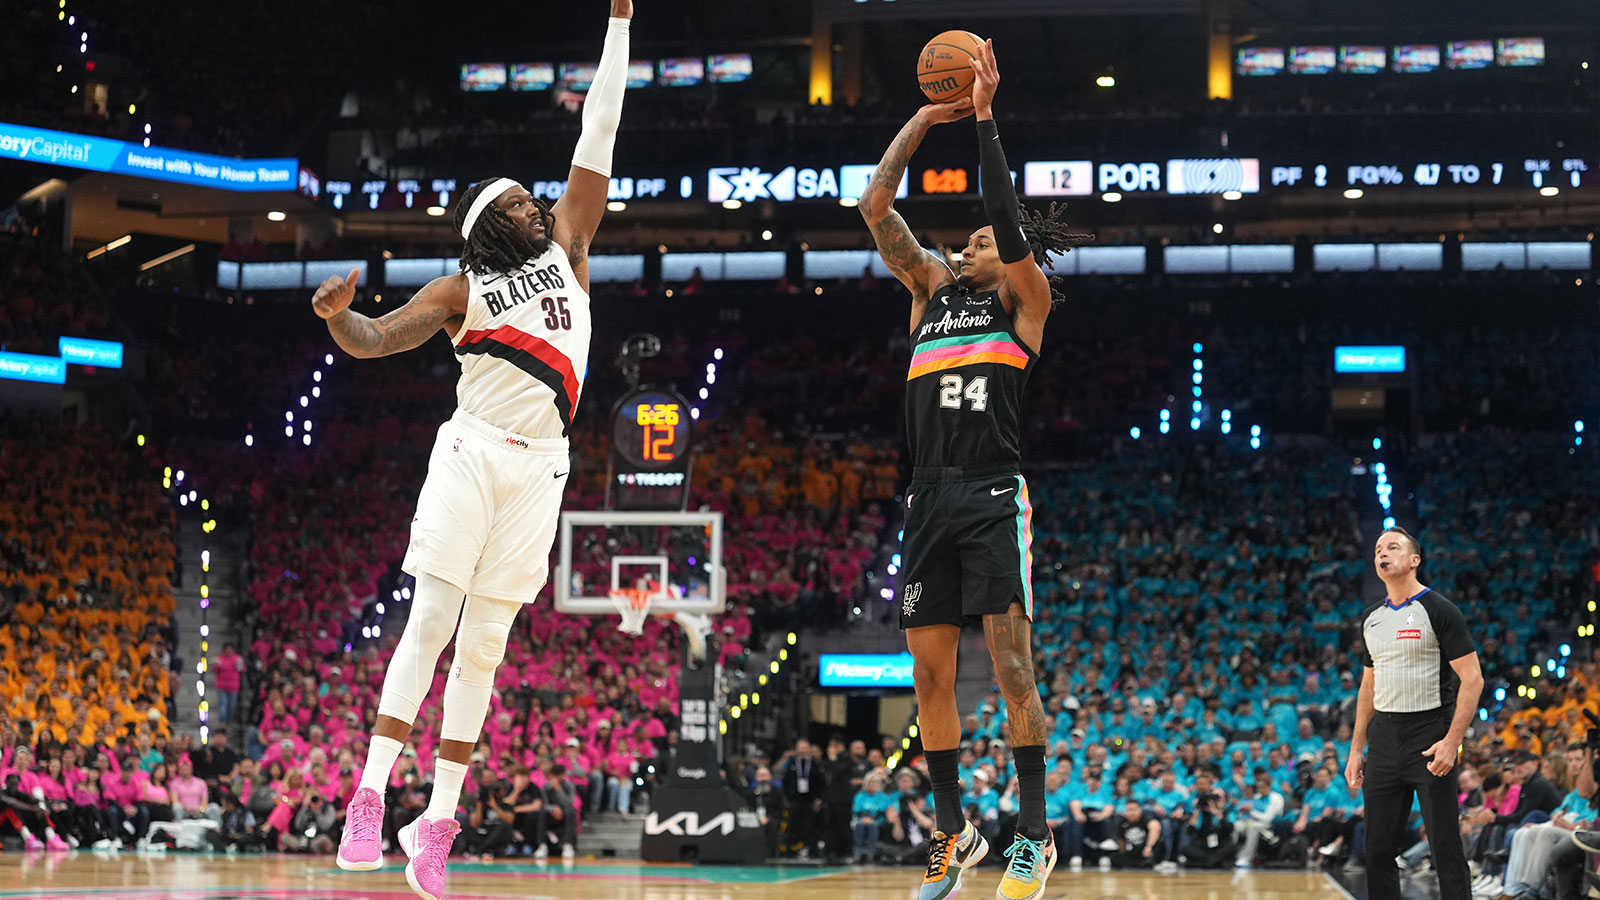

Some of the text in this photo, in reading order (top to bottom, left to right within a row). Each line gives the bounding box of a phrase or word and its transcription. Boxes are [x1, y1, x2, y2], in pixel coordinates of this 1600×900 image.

[127, 152, 290, 183] Invest with Your Home Team
[1099, 163, 1161, 192] POR
[1272, 166, 1302, 185] PF
[1348, 165, 1403, 185] FG%
[1448, 165, 1480, 184] TO
[432, 179, 456, 192] BLK
[636, 178, 666, 197] PF
[797, 168, 839, 198] SA
[1050, 170, 1072, 189] 12
[482, 264, 565, 317] BLAZERS
[541, 297, 572, 331] 35
[935, 310, 993, 334] Antonio
[940, 373, 988, 412] 24
[637, 403, 679, 426] 6:26
[506, 436, 529, 449] ripcity
[643, 425, 675, 461] 12
